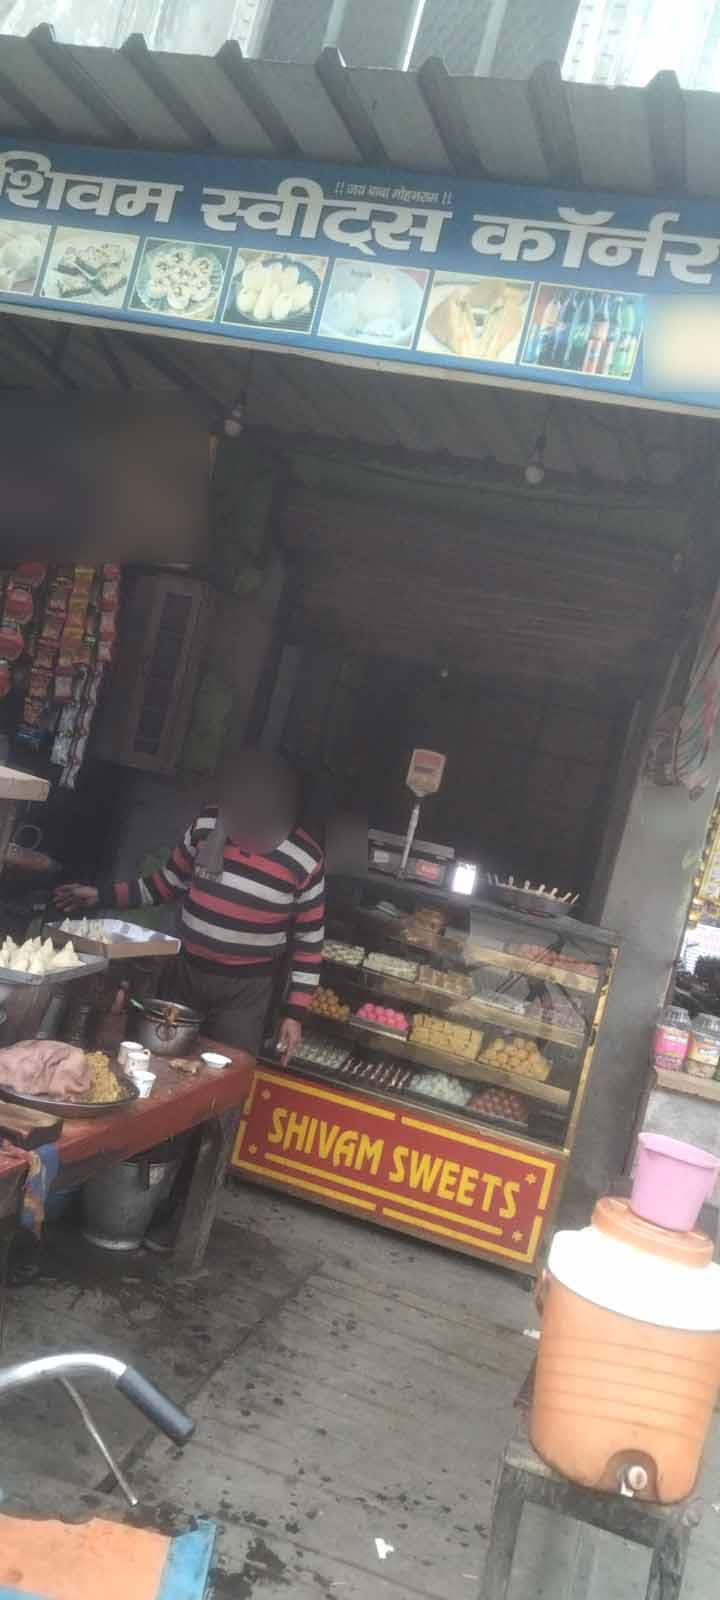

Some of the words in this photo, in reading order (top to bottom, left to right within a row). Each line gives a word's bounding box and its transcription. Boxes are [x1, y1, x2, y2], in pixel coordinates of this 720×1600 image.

[0, 150, 184, 223] शिवम
[200, 177, 453, 256] स्वीट्स
[471, 207, 720, 285] कॉर्नर
[268, 1107, 384, 1175] SHIVAM
[389, 1145, 520, 1219] SWEETS
